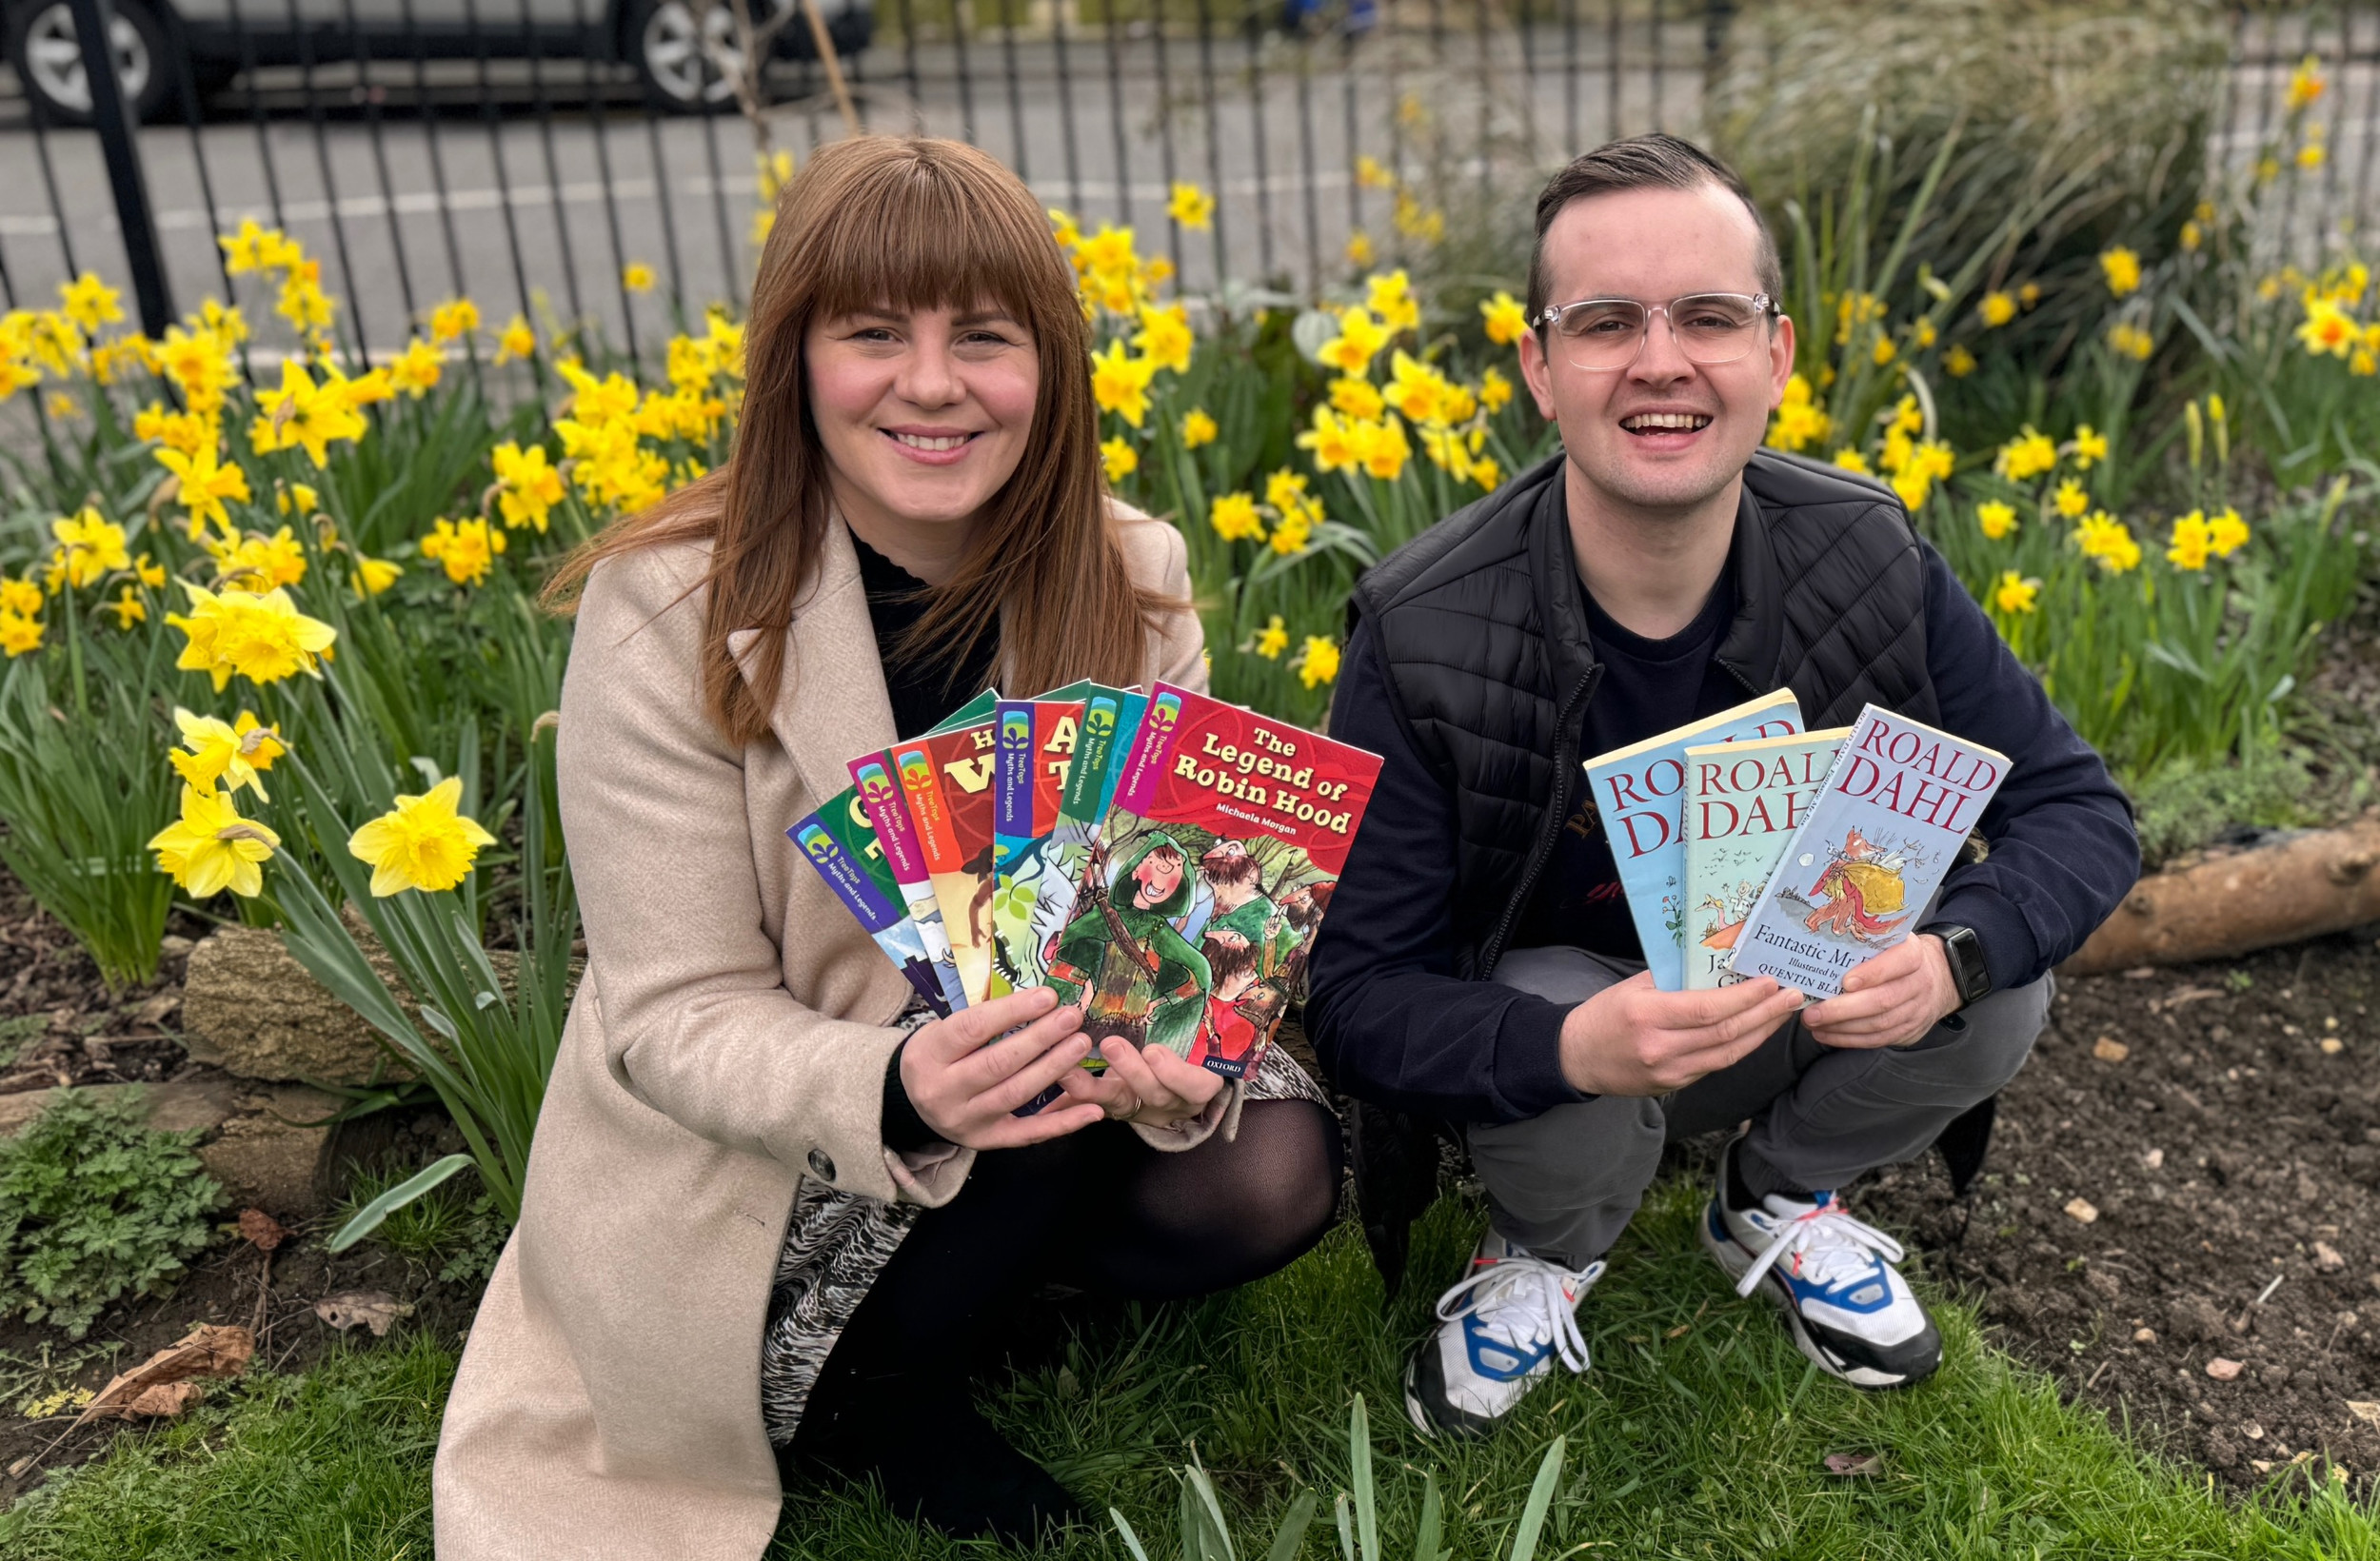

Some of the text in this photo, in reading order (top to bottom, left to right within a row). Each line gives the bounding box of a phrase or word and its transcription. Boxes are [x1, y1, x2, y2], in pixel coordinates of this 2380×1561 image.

[1253, 727, 1297, 758] The
[1849, 712, 1866, 741] ROALD
[1006, 753, 1015, 776] Myths
[1092, 740, 1107, 771] TreeTops
[1127, 731, 1157, 797] Myths and Legends
[1151, 735, 1168, 765] TreeTops
[1834, 742, 1850, 766] DAHL
[1857, 718, 1996, 792] ROALD
[1017, 753, 1026, 784] TreeTops
[1072, 737, 1095, 805] Myths and Legends
[1202, 733, 1348, 802] Legend of
[1696, 749, 1839, 797] ROAL
[1174, 754, 1352, 836] Robin Hood
[1815, 769, 1835, 800] Fantastic
[1835, 754, 1972, 835] DAHL
[889, 801, 904, 832] TreeTops
[926, 790, 940, 821] TreeTops
[1004, 790, 1014, 822] Legends
[1216, 803, 1297, 836] Michaela Morgan
[1696, 789, 1819, 840] DAH
[878, 805, 910, 872] Myths and Legends
[915, 793, 940, 861] Myths and Legends
[837, 856, 862, 884] TreeTops
[827, 862, 877, 920] Myths and Legends
[1754, 923, 1854, 968] Fantastic Mr
[1758, 963, 1815, 988] QUENTIN
[1816, 981, 1845, 996] BLA
[1788, 957, 1840, 981] Illustrated by
[1206, 1059, 1242, 1073] OXFORD
